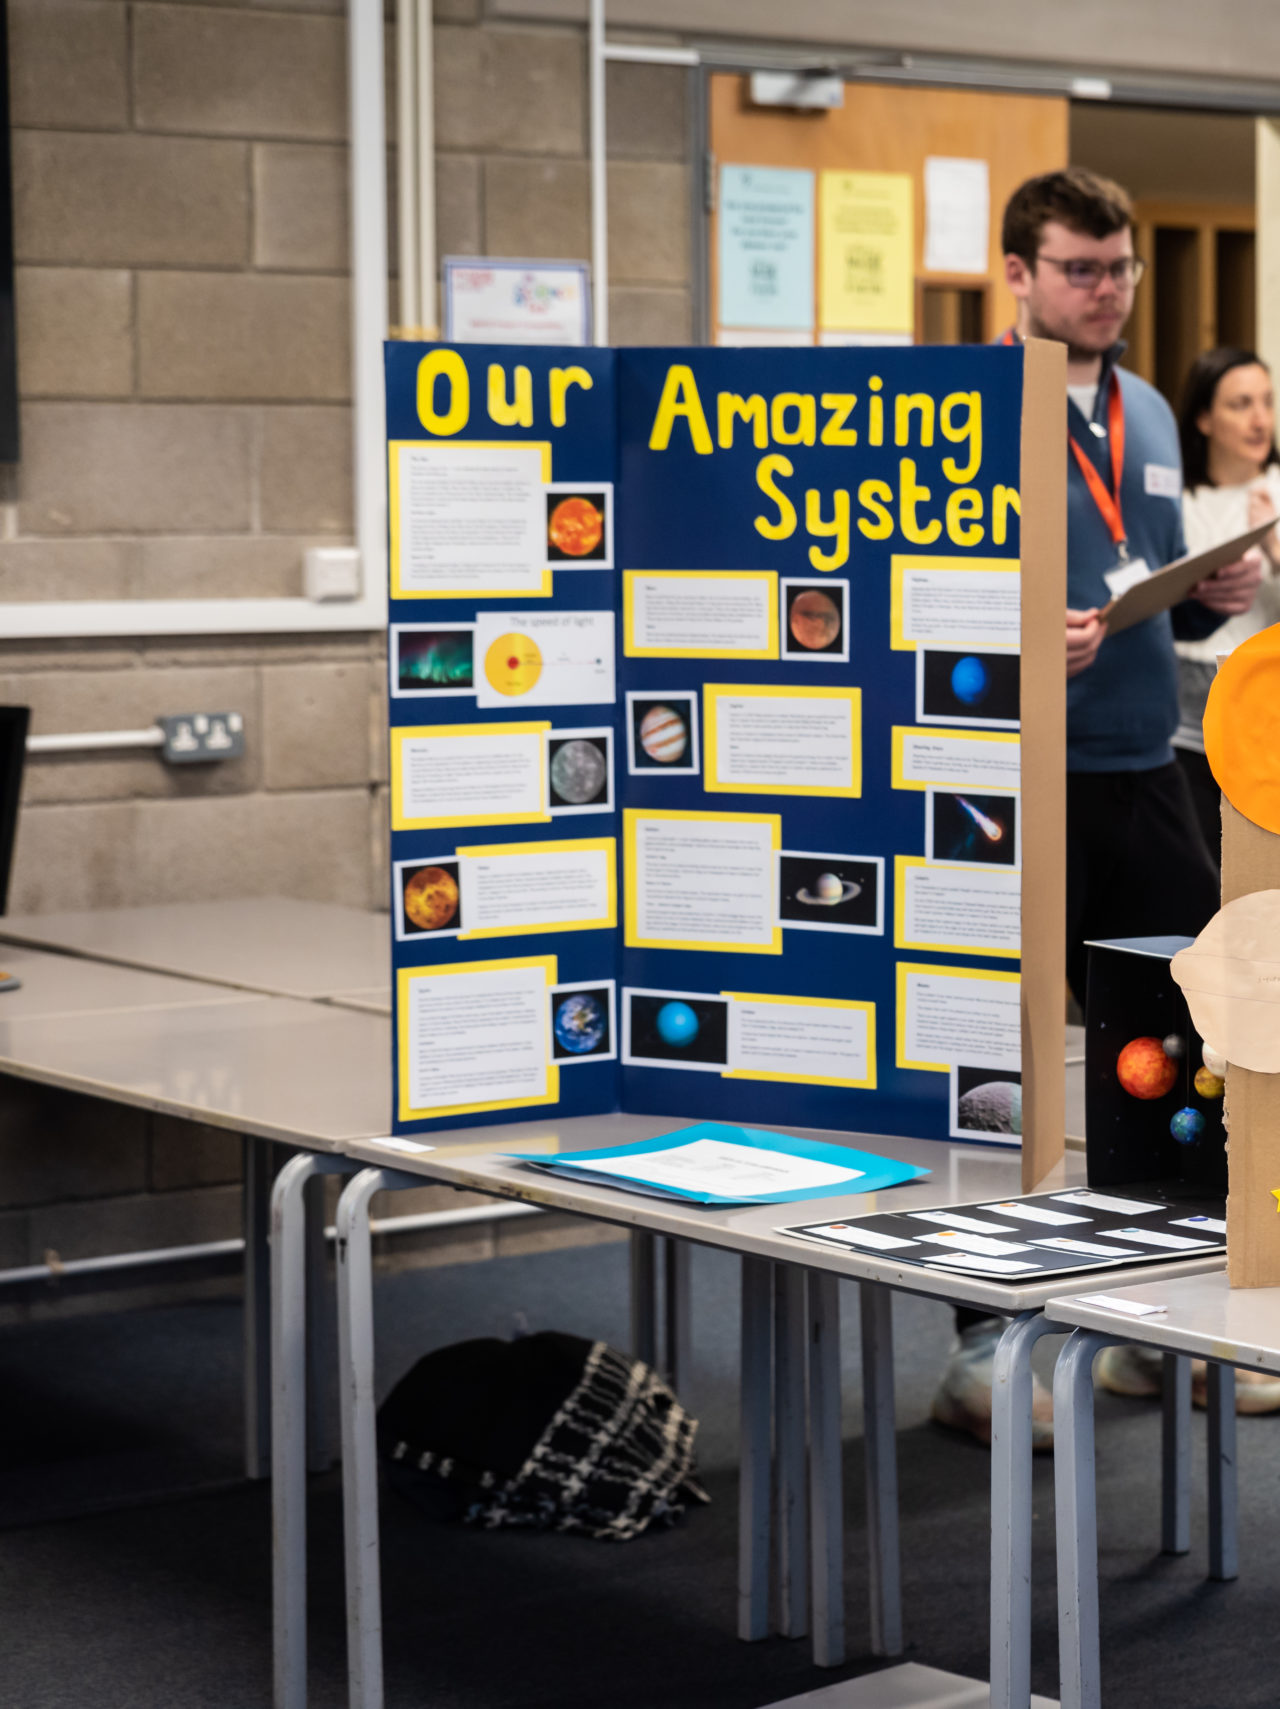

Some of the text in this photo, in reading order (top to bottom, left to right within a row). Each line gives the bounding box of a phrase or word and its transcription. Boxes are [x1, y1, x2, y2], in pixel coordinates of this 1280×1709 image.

[416, 349, 593, 436] Our
[649, 364, 982, 484] Amazing
[510, 617, 594, 628] The speed of light
